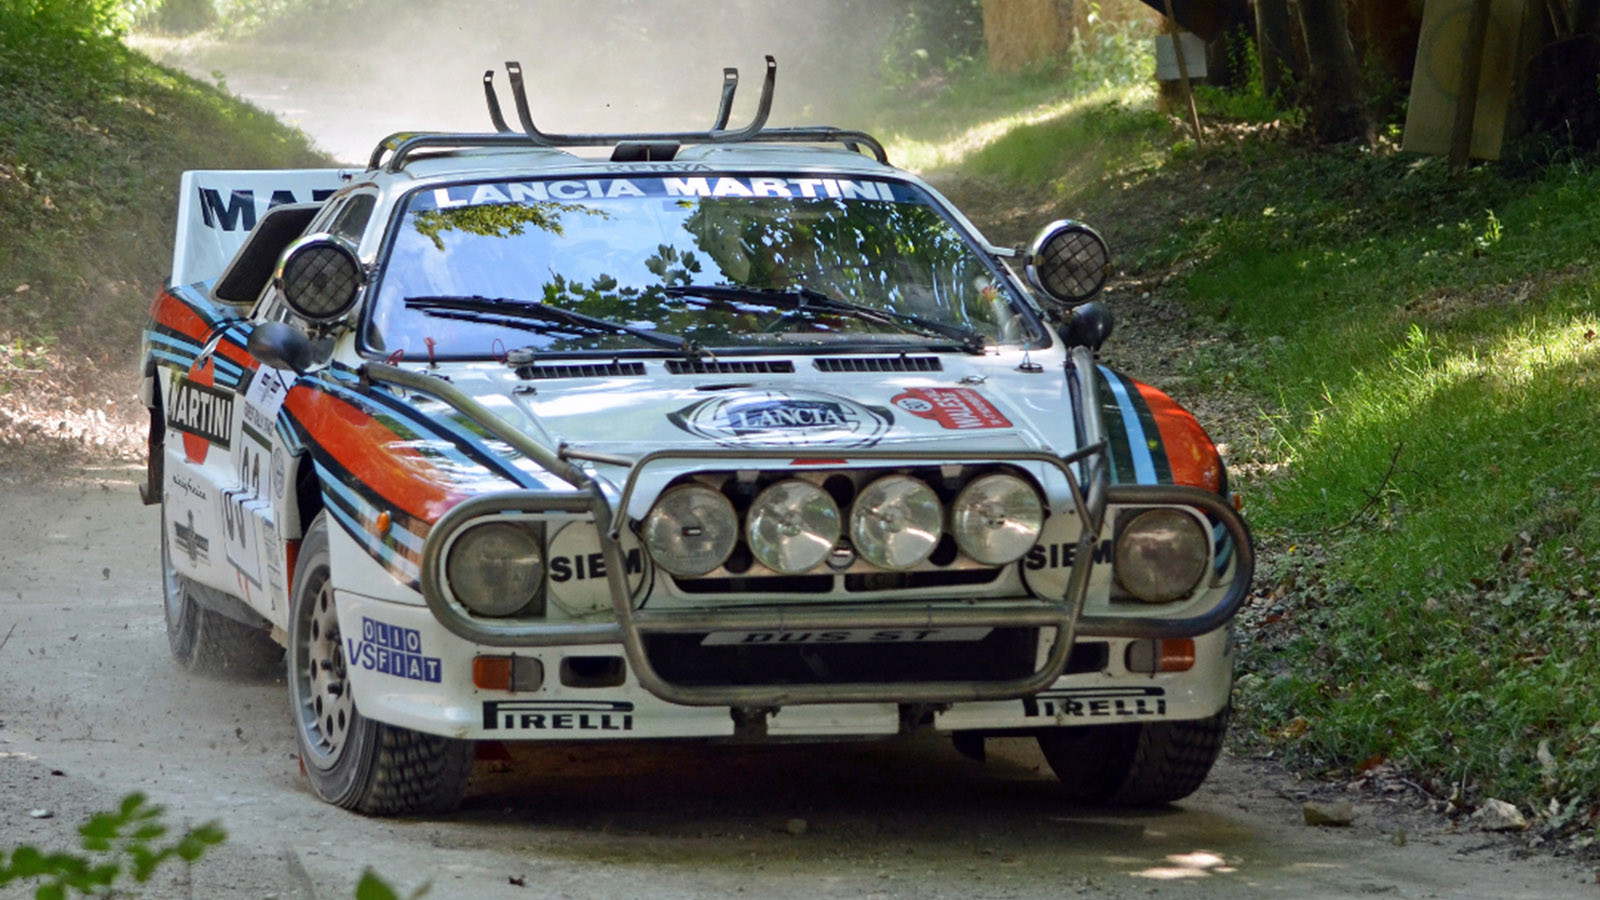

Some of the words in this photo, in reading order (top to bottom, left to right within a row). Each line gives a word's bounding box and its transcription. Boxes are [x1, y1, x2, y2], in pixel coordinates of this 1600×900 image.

[433, 177, 648, 208] LANCIA
[661, 176, 896, 201] MARTINI
[168, 380, 232, 440] MARTINI
[739, 408, 848, 427] LANCIA
[364, 619, 420, 652] OLIO
[378, 649, 440, 681] FIAT
[482, 701, 634, 730] PIRELLI
[1022, 687, 1166, 717] PIRELLI
